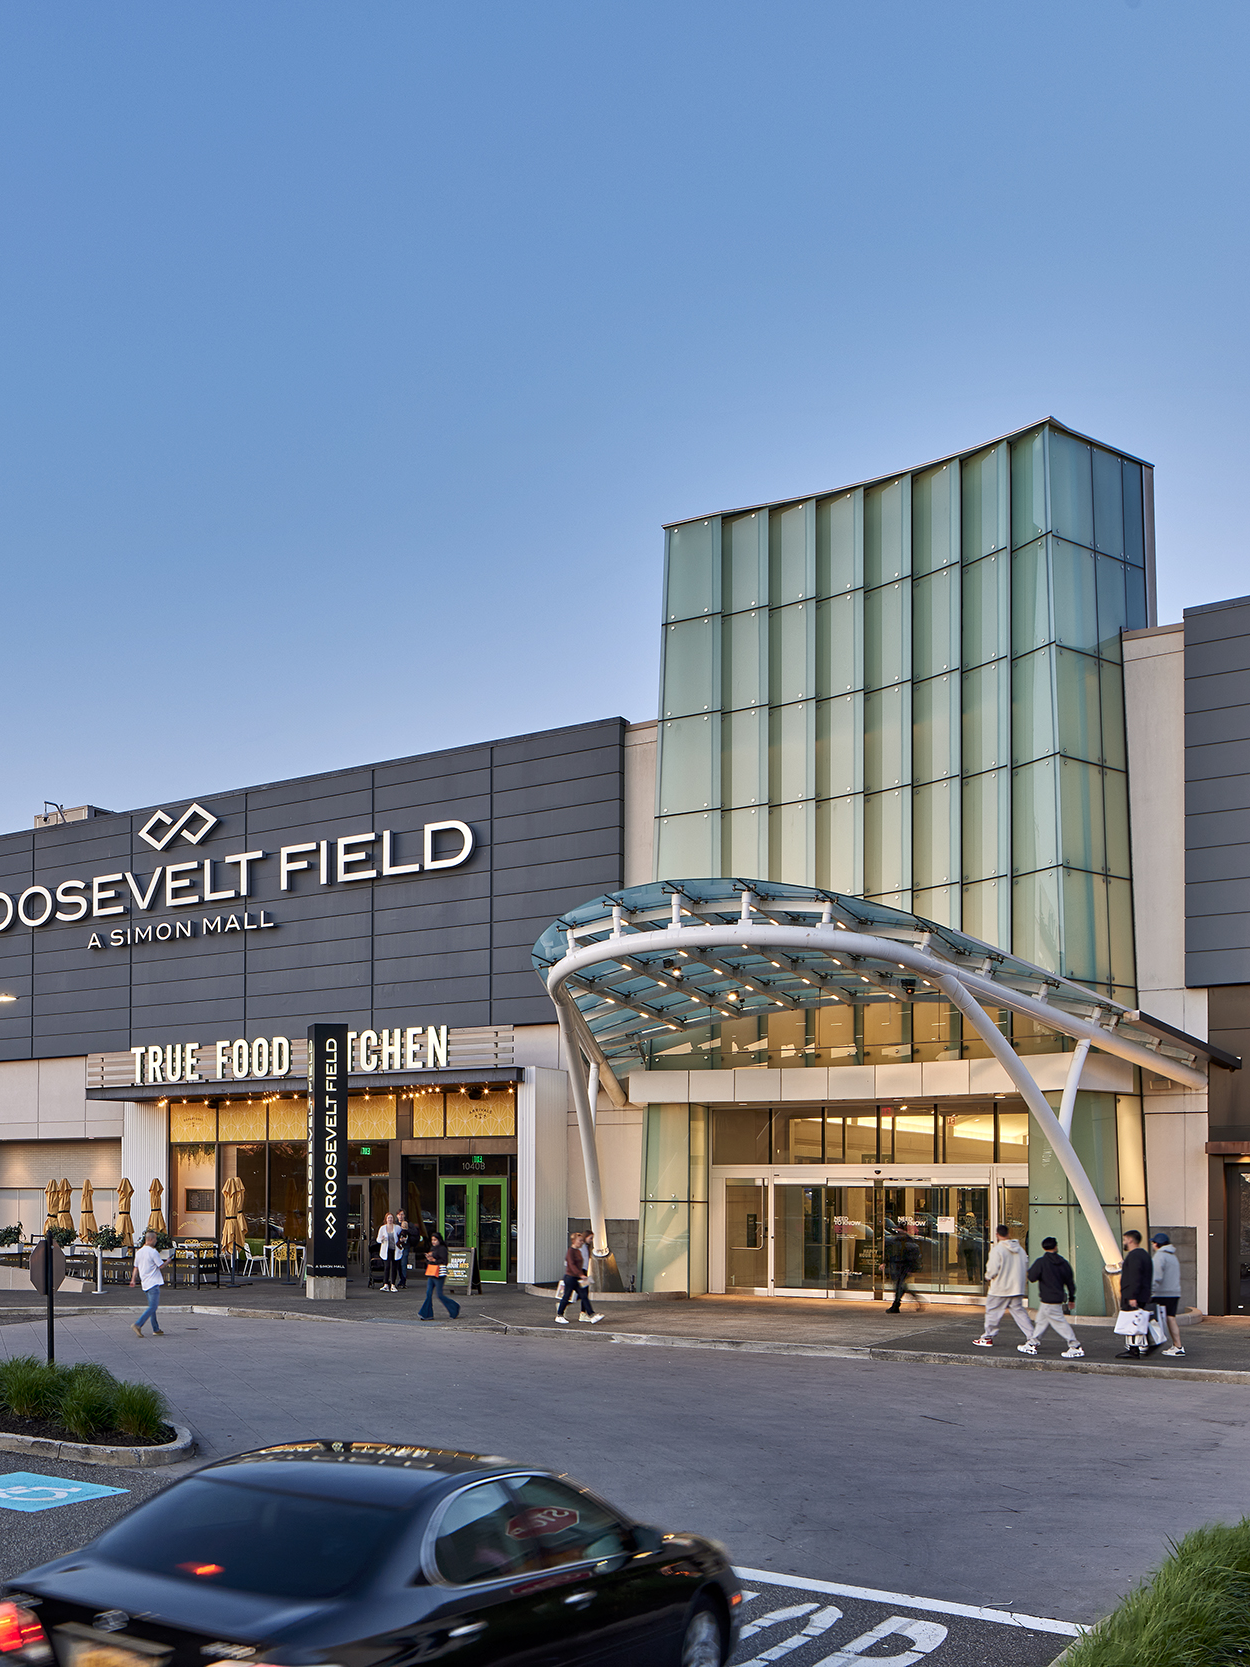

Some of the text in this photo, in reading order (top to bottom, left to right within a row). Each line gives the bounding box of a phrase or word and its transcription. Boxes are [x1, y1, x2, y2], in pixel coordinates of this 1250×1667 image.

[281, 820, 475, 891] FIELD
[87, 910, 275, 950] A SIMON MALL
[131, 1025, 449, 1084] TRUE FOOD TCHEN
[325, 1038, 338, 1208] ROOSEVELT FIELD
[462, 1162, 486, 1171] 1040B
